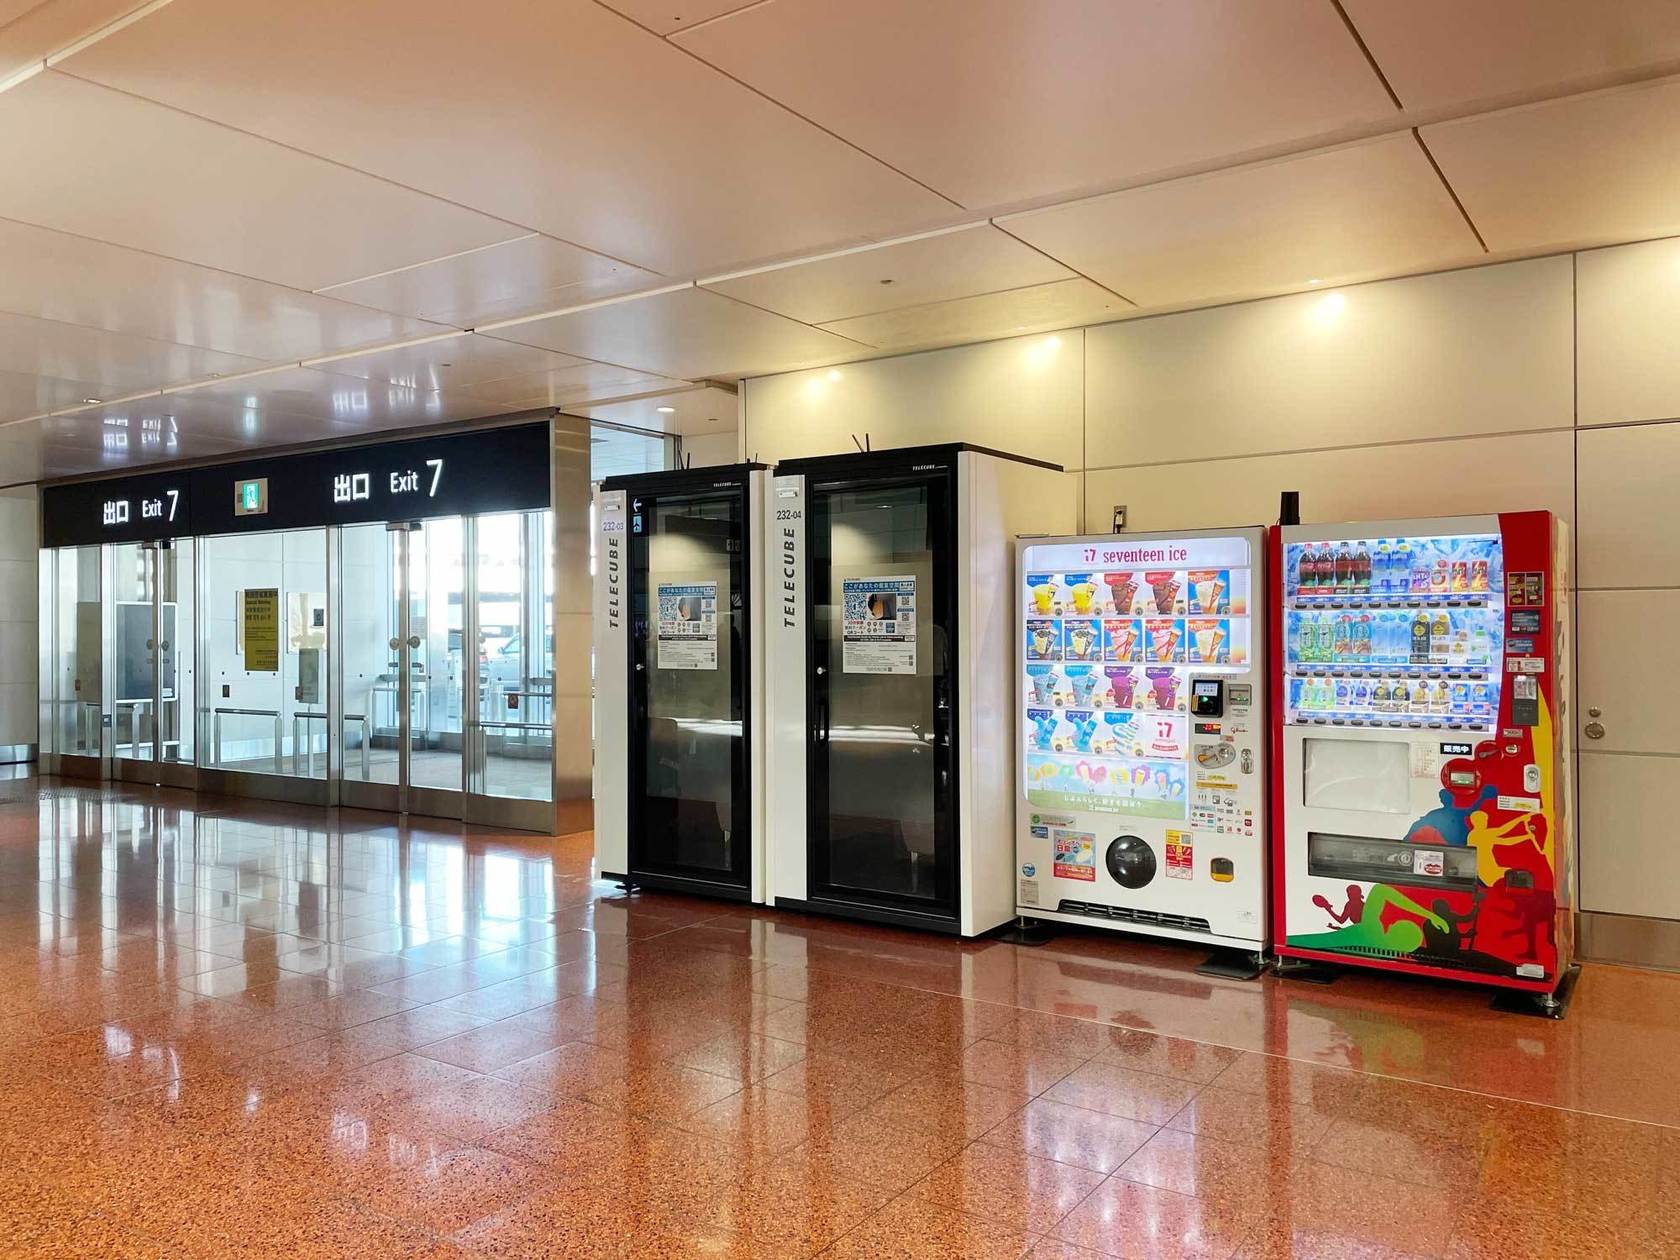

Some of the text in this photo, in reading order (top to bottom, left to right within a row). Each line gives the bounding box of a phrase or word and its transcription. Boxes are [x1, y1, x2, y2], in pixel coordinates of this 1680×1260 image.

[333, 459, 443, 503] 出口 Exit 7
[103, 490, 179, 525] 出口 Exit 7
[776, 510, 802, 520] 232-04
[603, 521, 624, 531] 232-03
[1103, 548, 1164, 563] seventeen
[1168, 545, 1188, 561] ice
[608, 538, 619, 628] TELECUBE
[783, 528, 796, 628] TELECUBE
[1443, 744, 1470, 754] 販売中
